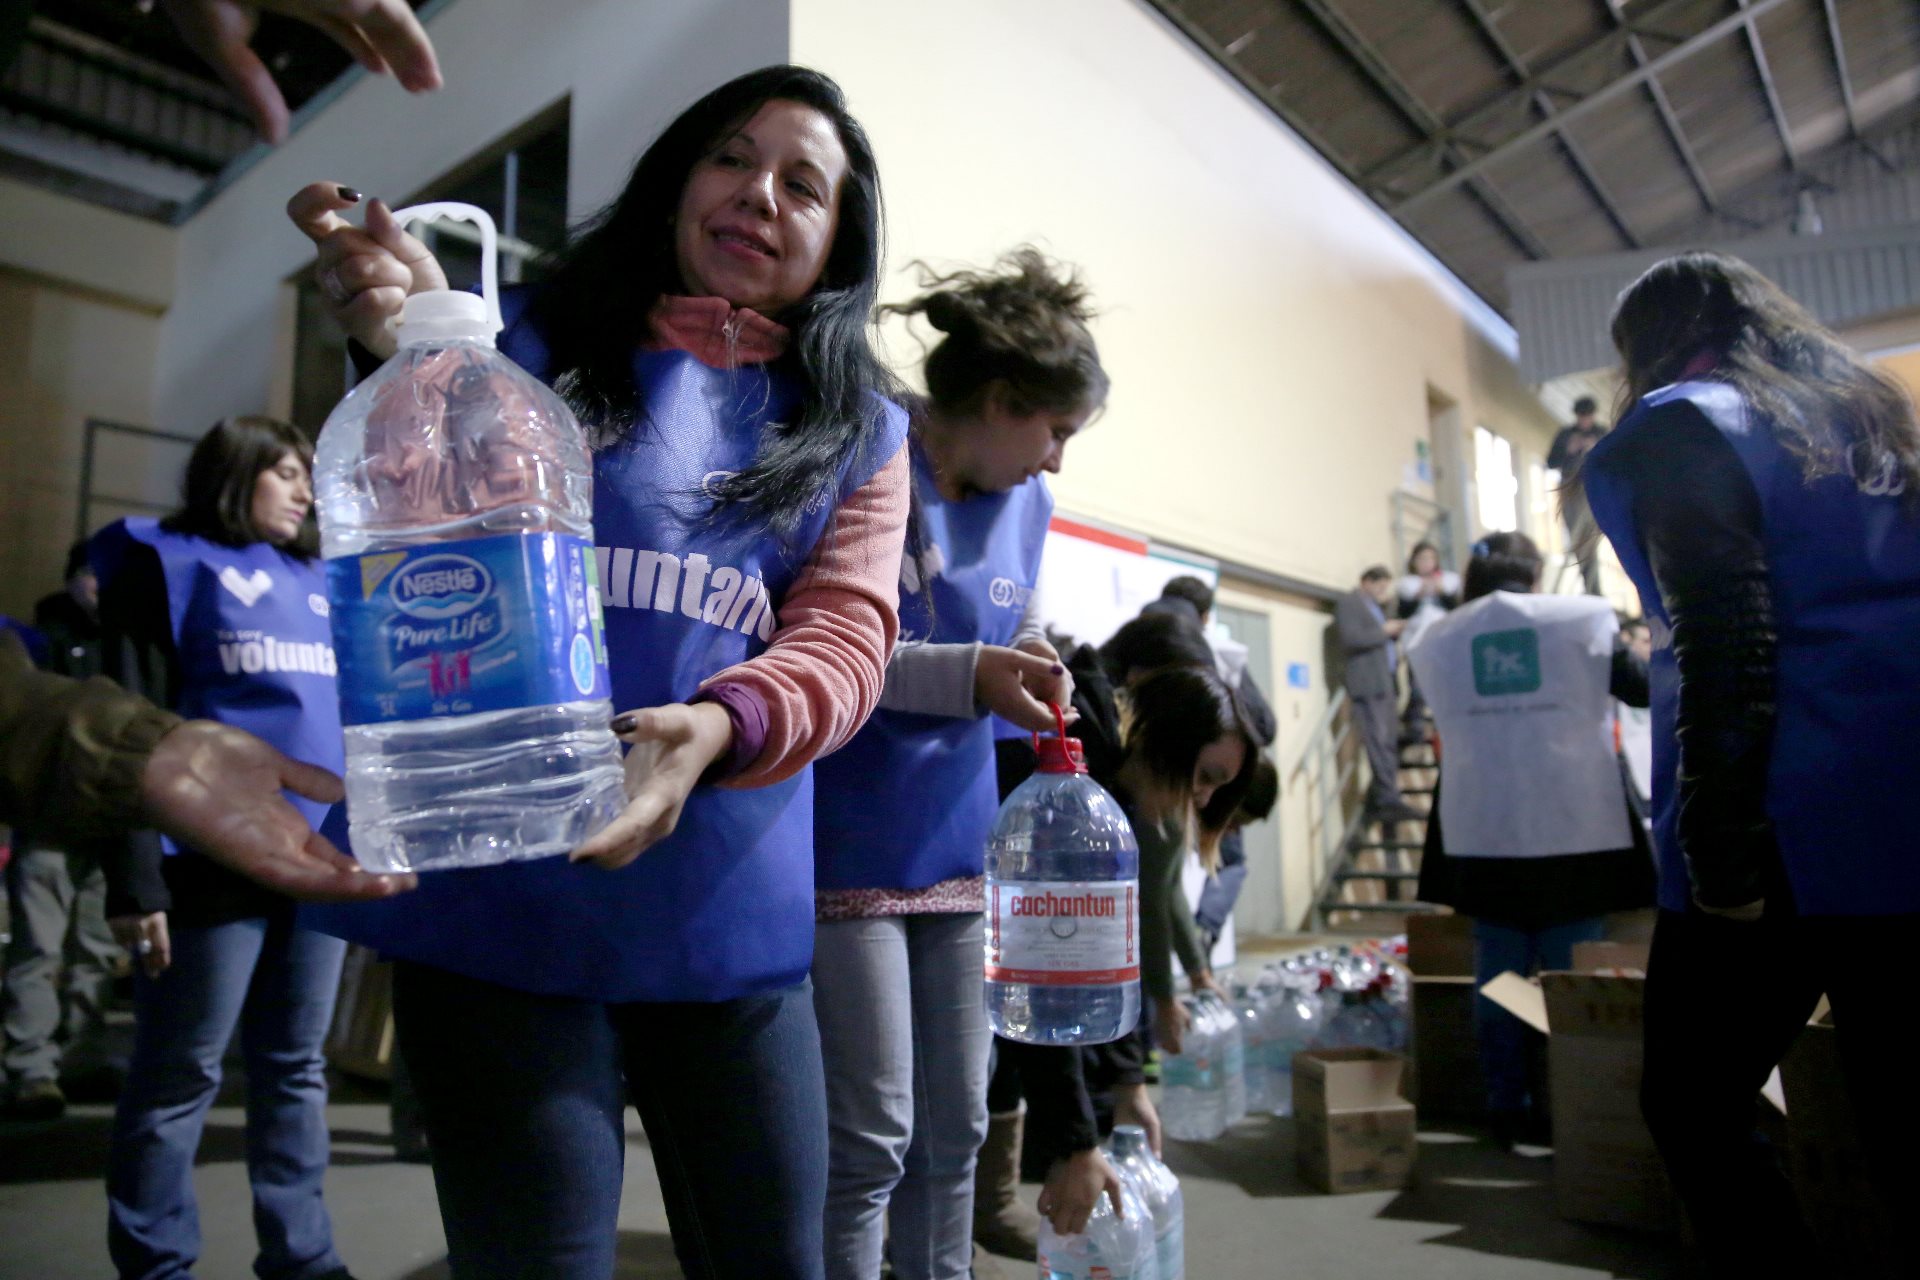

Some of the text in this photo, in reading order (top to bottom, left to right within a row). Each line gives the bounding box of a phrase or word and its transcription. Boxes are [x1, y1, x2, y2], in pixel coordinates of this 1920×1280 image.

[402, 567, 477, 598] Nestlé
[395, 612, 493, 652] Pure Life
[218, 635, 337, 677] volunta
[1010, 891, 1116, 917] cachantun
